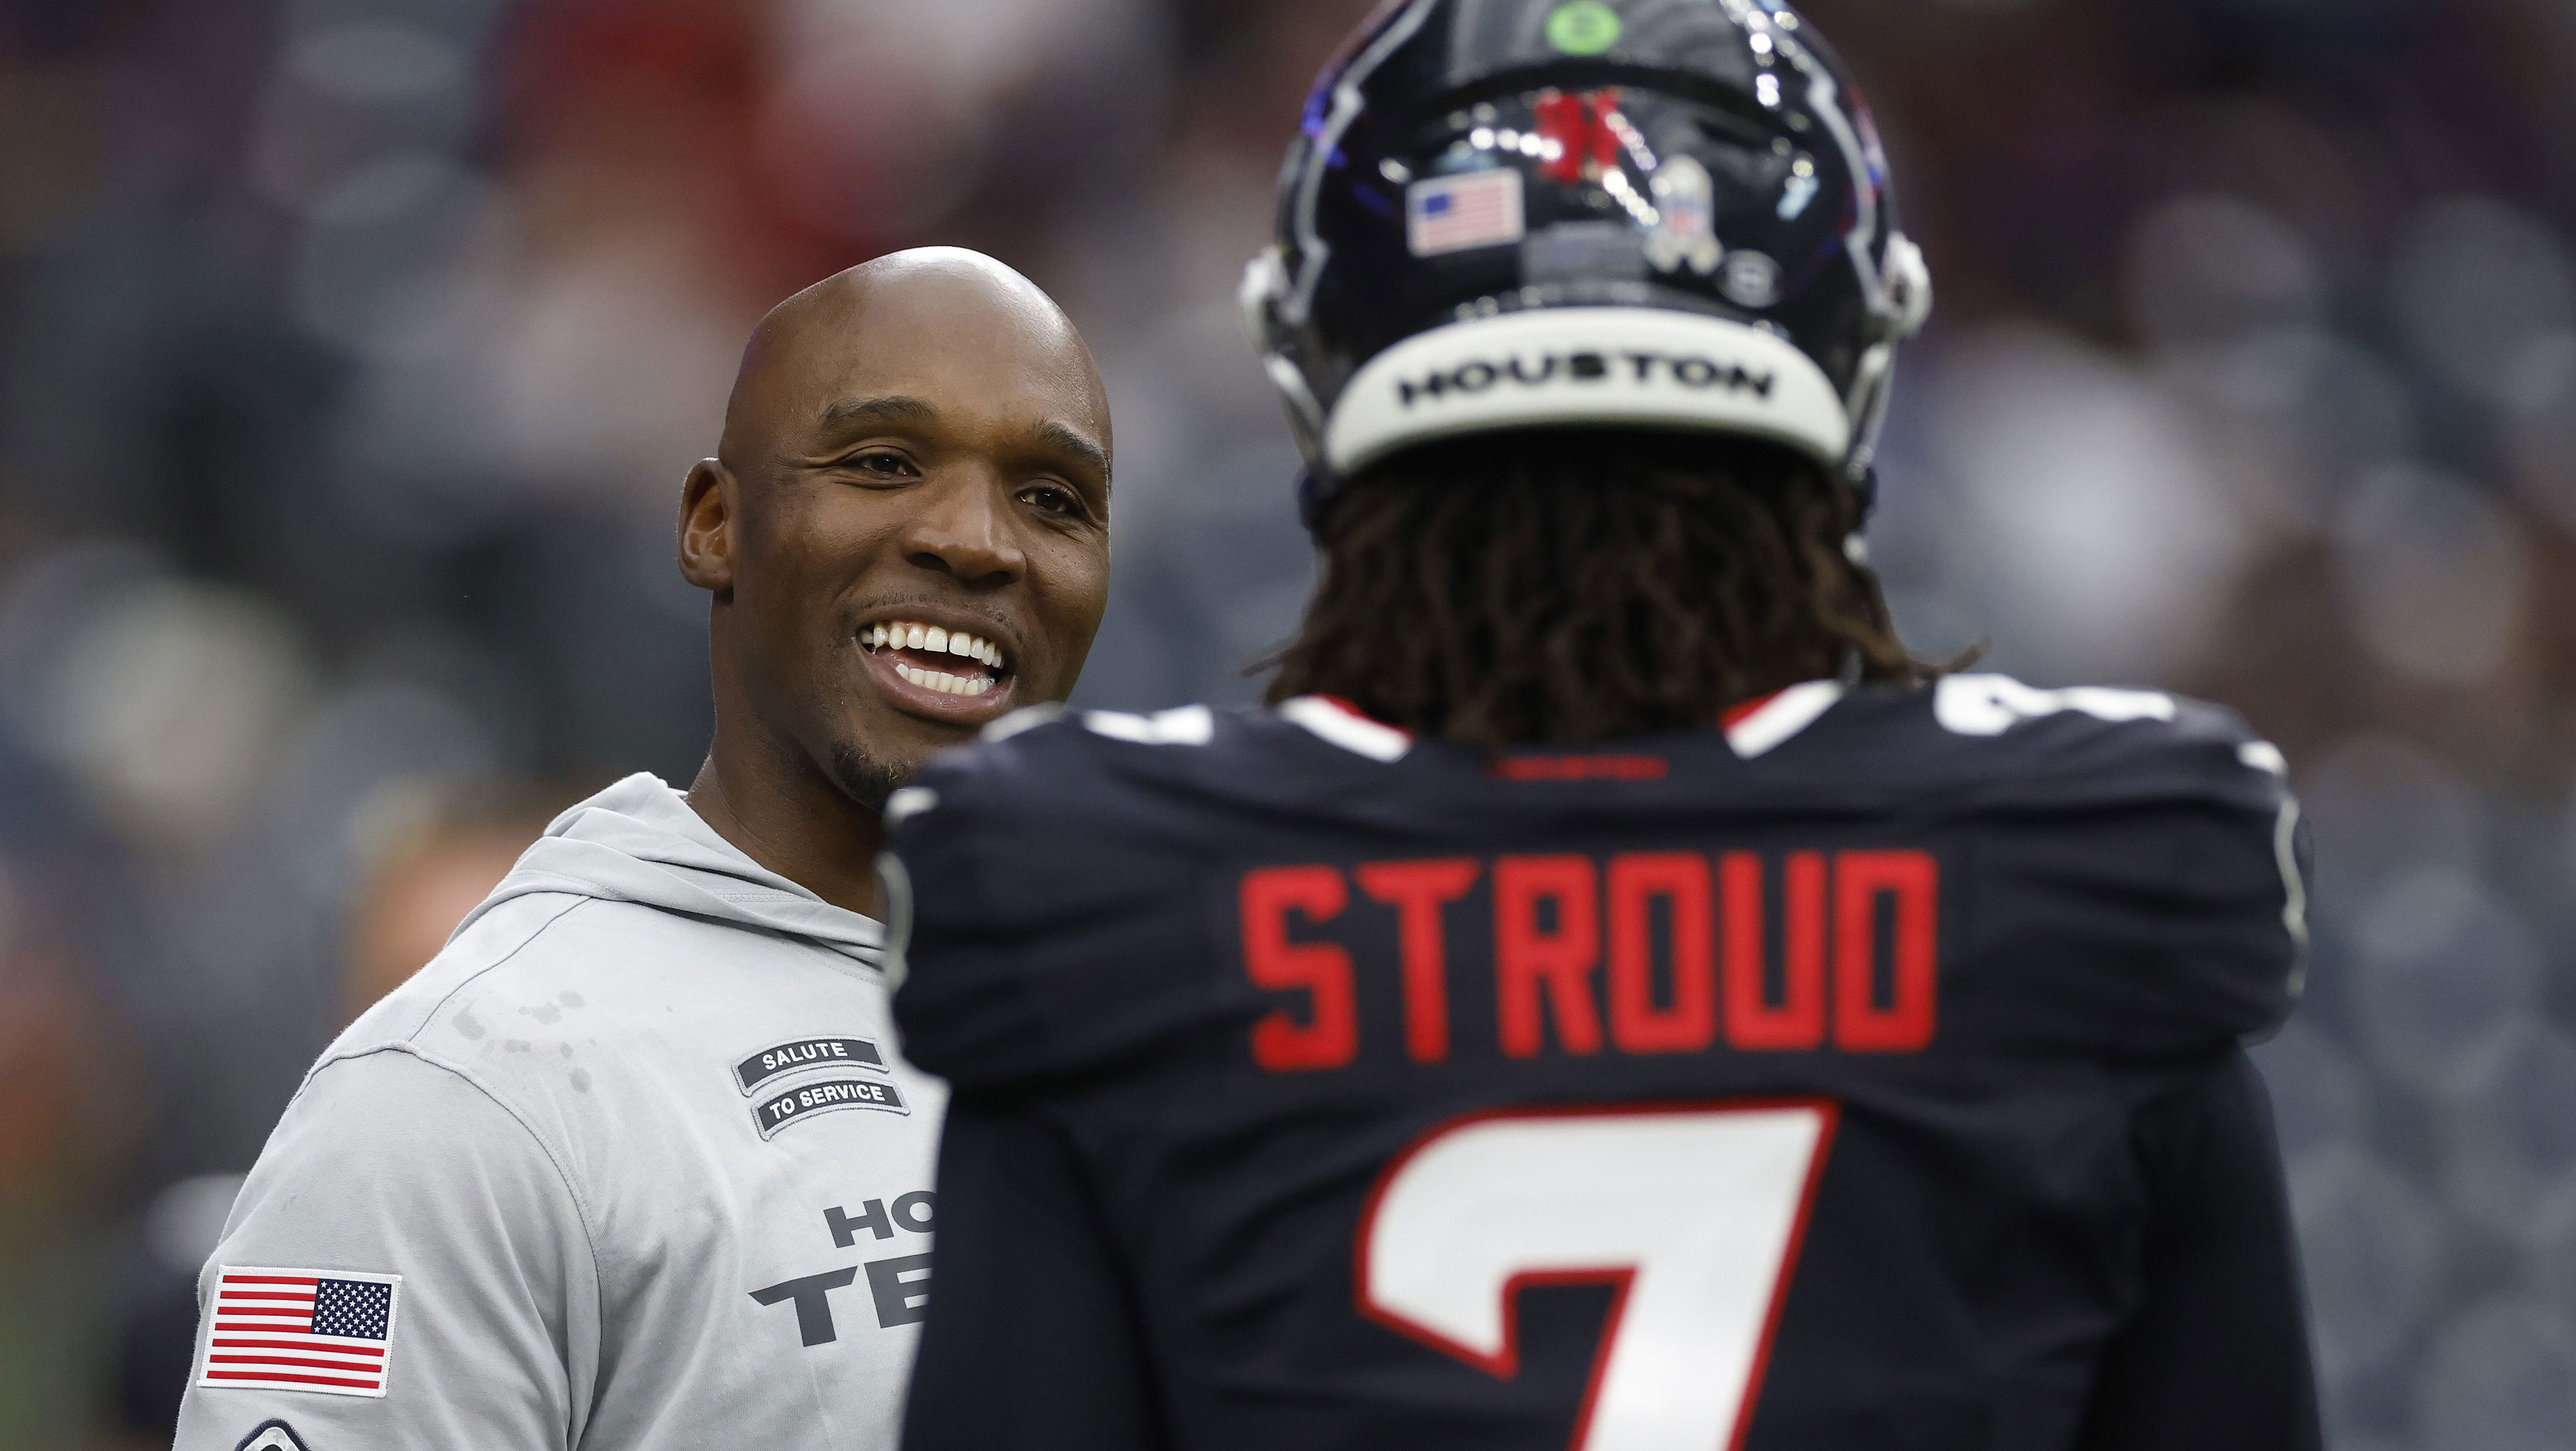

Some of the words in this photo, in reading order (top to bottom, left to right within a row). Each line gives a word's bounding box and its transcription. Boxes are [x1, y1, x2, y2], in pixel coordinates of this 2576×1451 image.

[1397, 353, 1773, 405] HOUSTON
[1238, 847, 1939, 1072] STROUD
[762, 1042, 848, 1070] SALUTE
[769, 1098, 795, 1119] TO
[799, 1084, 886, 1107] SERVICE
[1353, 1098, 1839, 1451] 7
